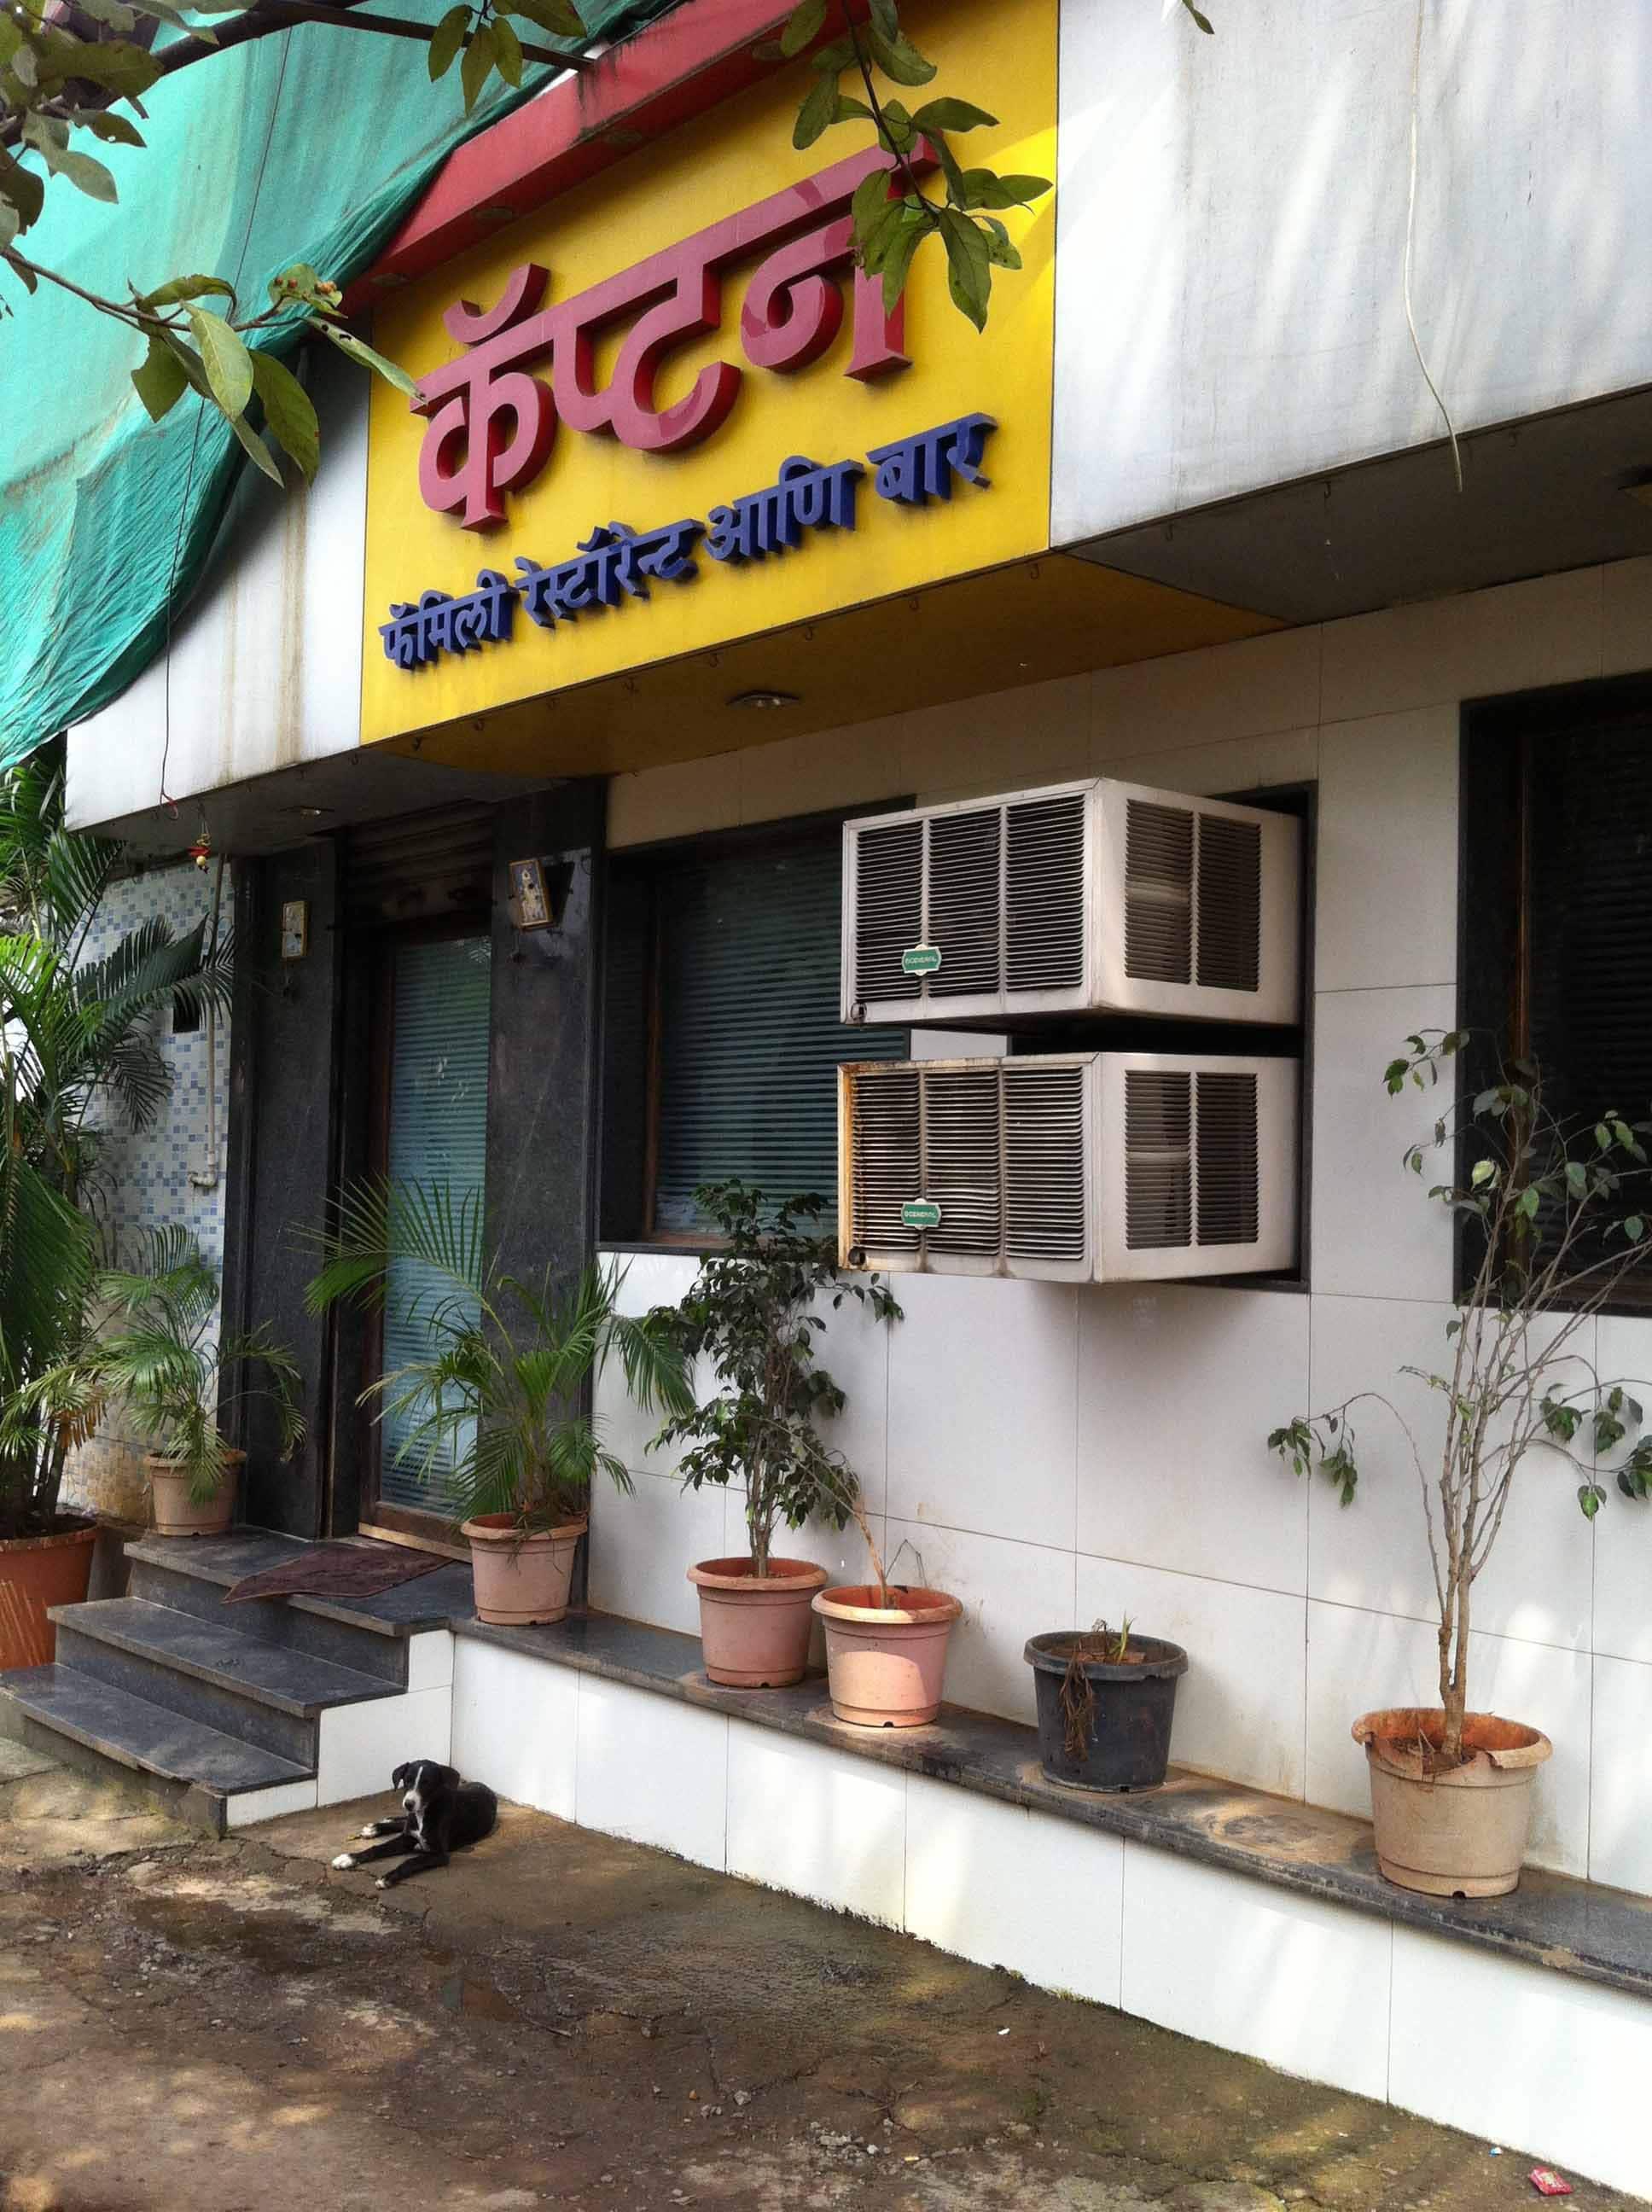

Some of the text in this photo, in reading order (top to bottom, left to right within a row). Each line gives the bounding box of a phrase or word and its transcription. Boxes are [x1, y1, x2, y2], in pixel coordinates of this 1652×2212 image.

[410, 133, 942, 533] कॅप्टन
[378, 568, 518, 670] फॅमिली
[702, 455, 867, 562] आणि
[865, 412, 998, 507] बार
